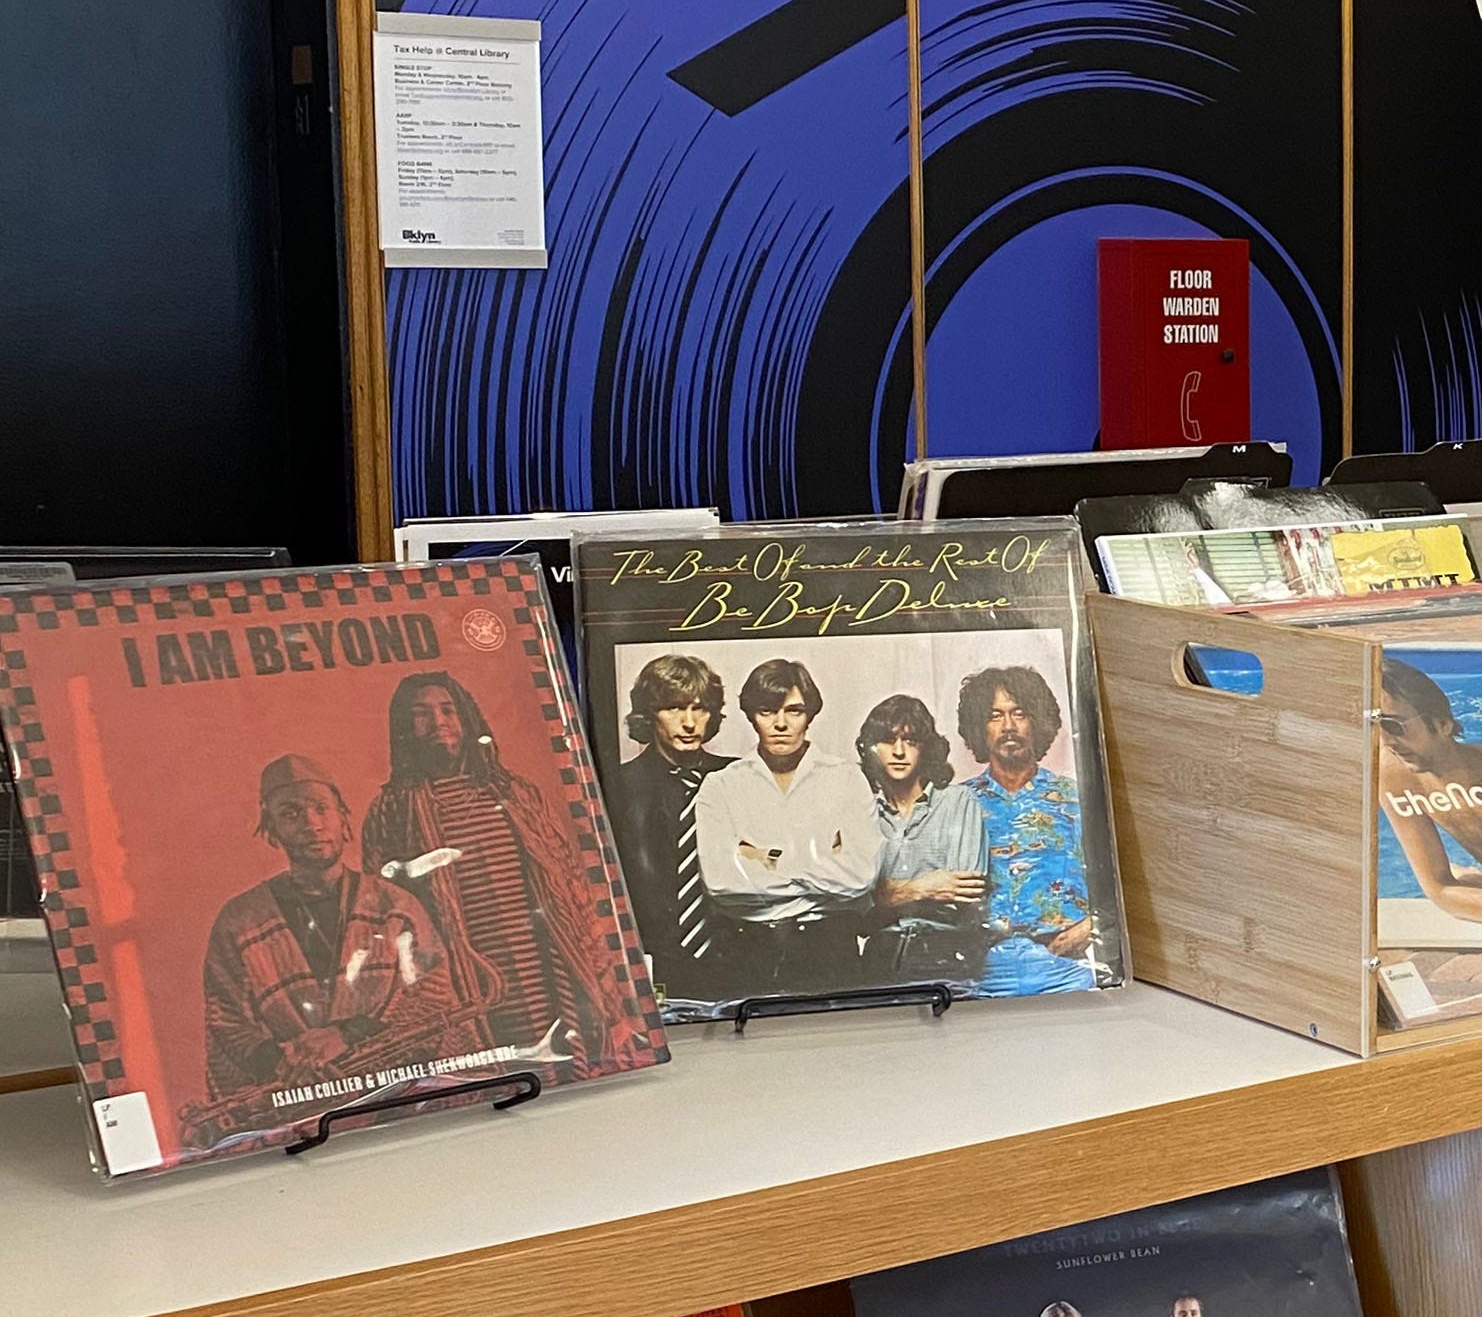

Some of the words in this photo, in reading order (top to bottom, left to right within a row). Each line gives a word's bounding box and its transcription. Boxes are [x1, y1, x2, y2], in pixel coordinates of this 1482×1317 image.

[394, 45, 409, 53] Tax
[412, 46, 432, 55] Help
[445, 47, 477, 56] Central
[480, 50, 509, 58] Library
[402, 230, 435, 241] Bklyn
[1170, 270, 1212, 289] FLOOR
[1163, 297, 1219, 316] WARDEN
[1164, 324, 1219, 344] STATION
[1232, 445, 1247, 453] M
[612, 550, 669, 585] The
[659, 550, 747, 583] Best
[753, 543, 807, 581] Of
[800, 546, 871, 569] and
[872, 545, 923, 567] the
[929, 543, 999, 580] Rest
[1001, 535, 1050, 574] Of
[669, 582, 753, 631] Be
[741, 582, 856, 634] Bop
[849, 579, 1011, 626] Deluxe
[121, 637, 146, 687] I
[156, 630, 240, 685] AM
[246, 613, 441, 676] BEYOND
[272, 1087, 314, 1107] ISAIAH
[315, 1076, 363, 1100] COLLIER
[365, 1074, 376, 1088] &
[377, 1063, 425, 1088] MICHAEL
[1056, 1252, 1125, 1270] SUNFLOWER
[1130, 1246, 1160, 1258] BEAN
